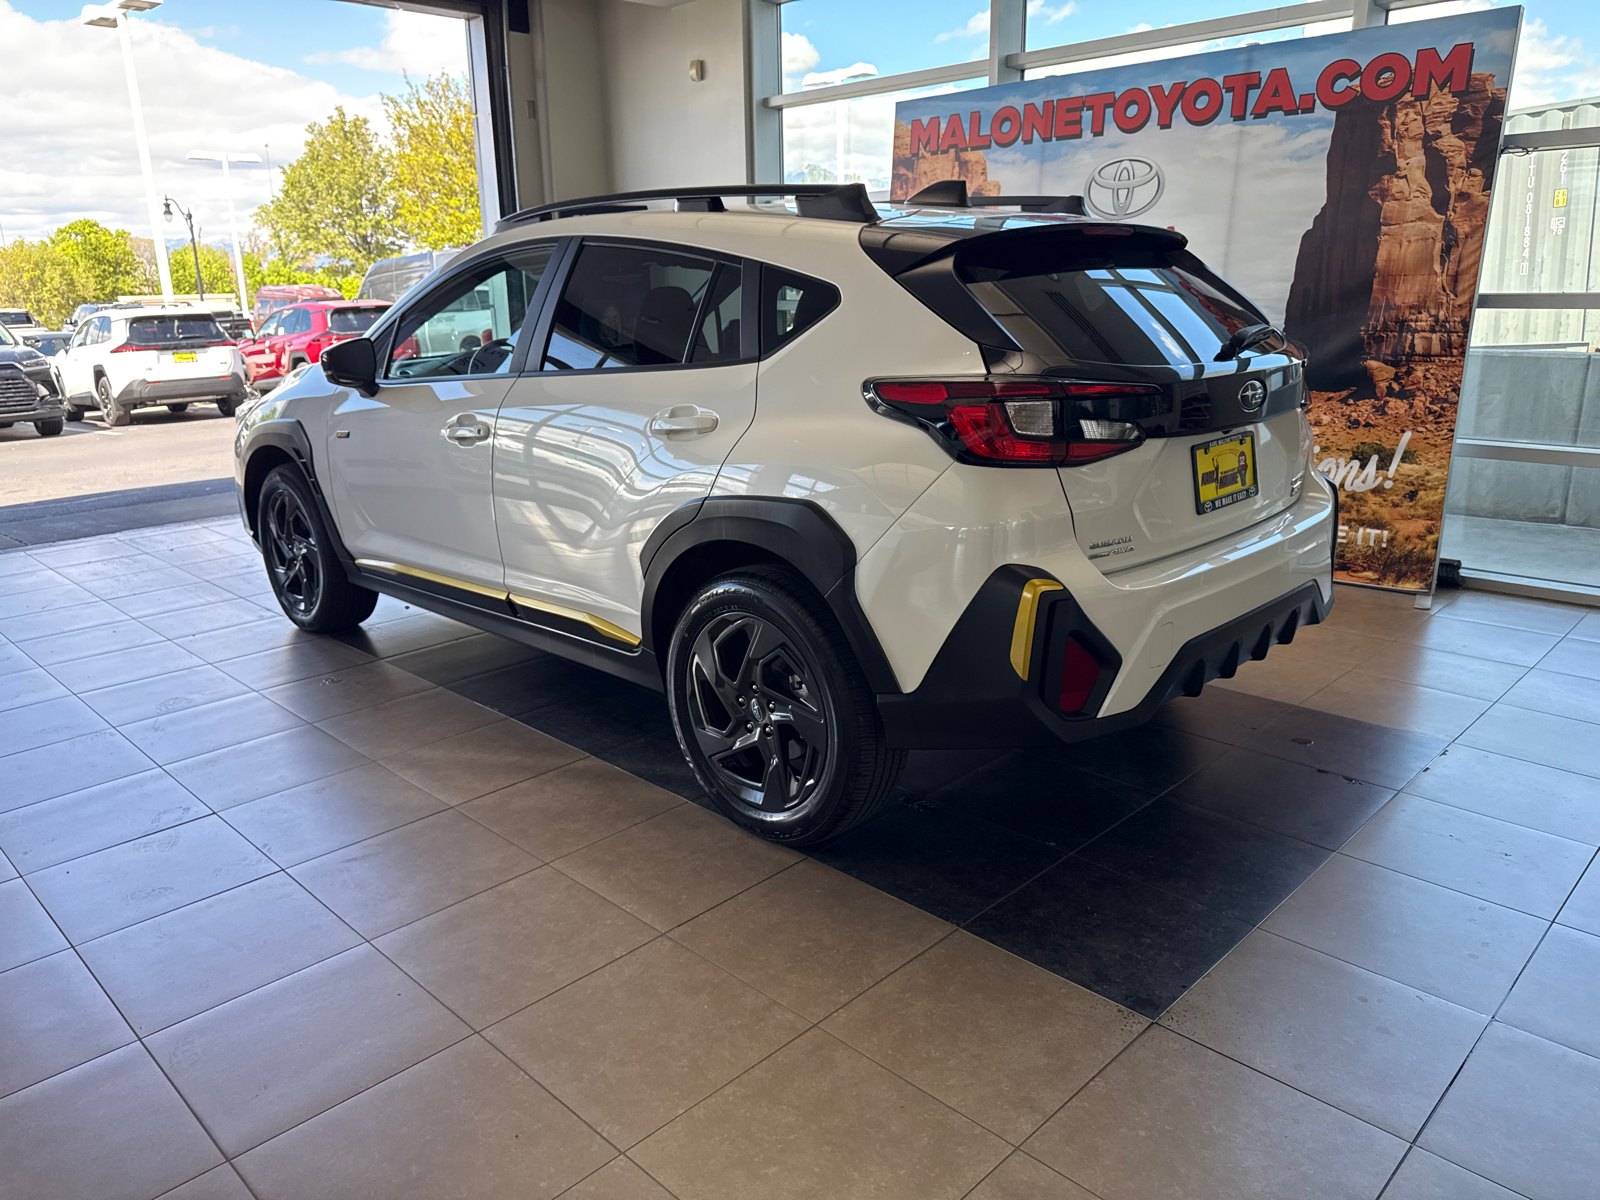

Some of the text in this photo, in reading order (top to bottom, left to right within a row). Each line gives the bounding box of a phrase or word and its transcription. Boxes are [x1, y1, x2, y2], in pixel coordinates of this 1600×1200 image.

[909, 42, 1475, 158] MALONETOYOTA.COM
[1522, 191, 1534, 259] 081884
[1239, 455, 1246, 466] 32
[1314, 431, 1412, 492] ons!
[1215, 498, 1222, 508] WE
[1222, 495, 1233, 506] MAKE
[1089, 535, 1133, 550] SUBARU
[1357, 527, 1389, 548] IT!
